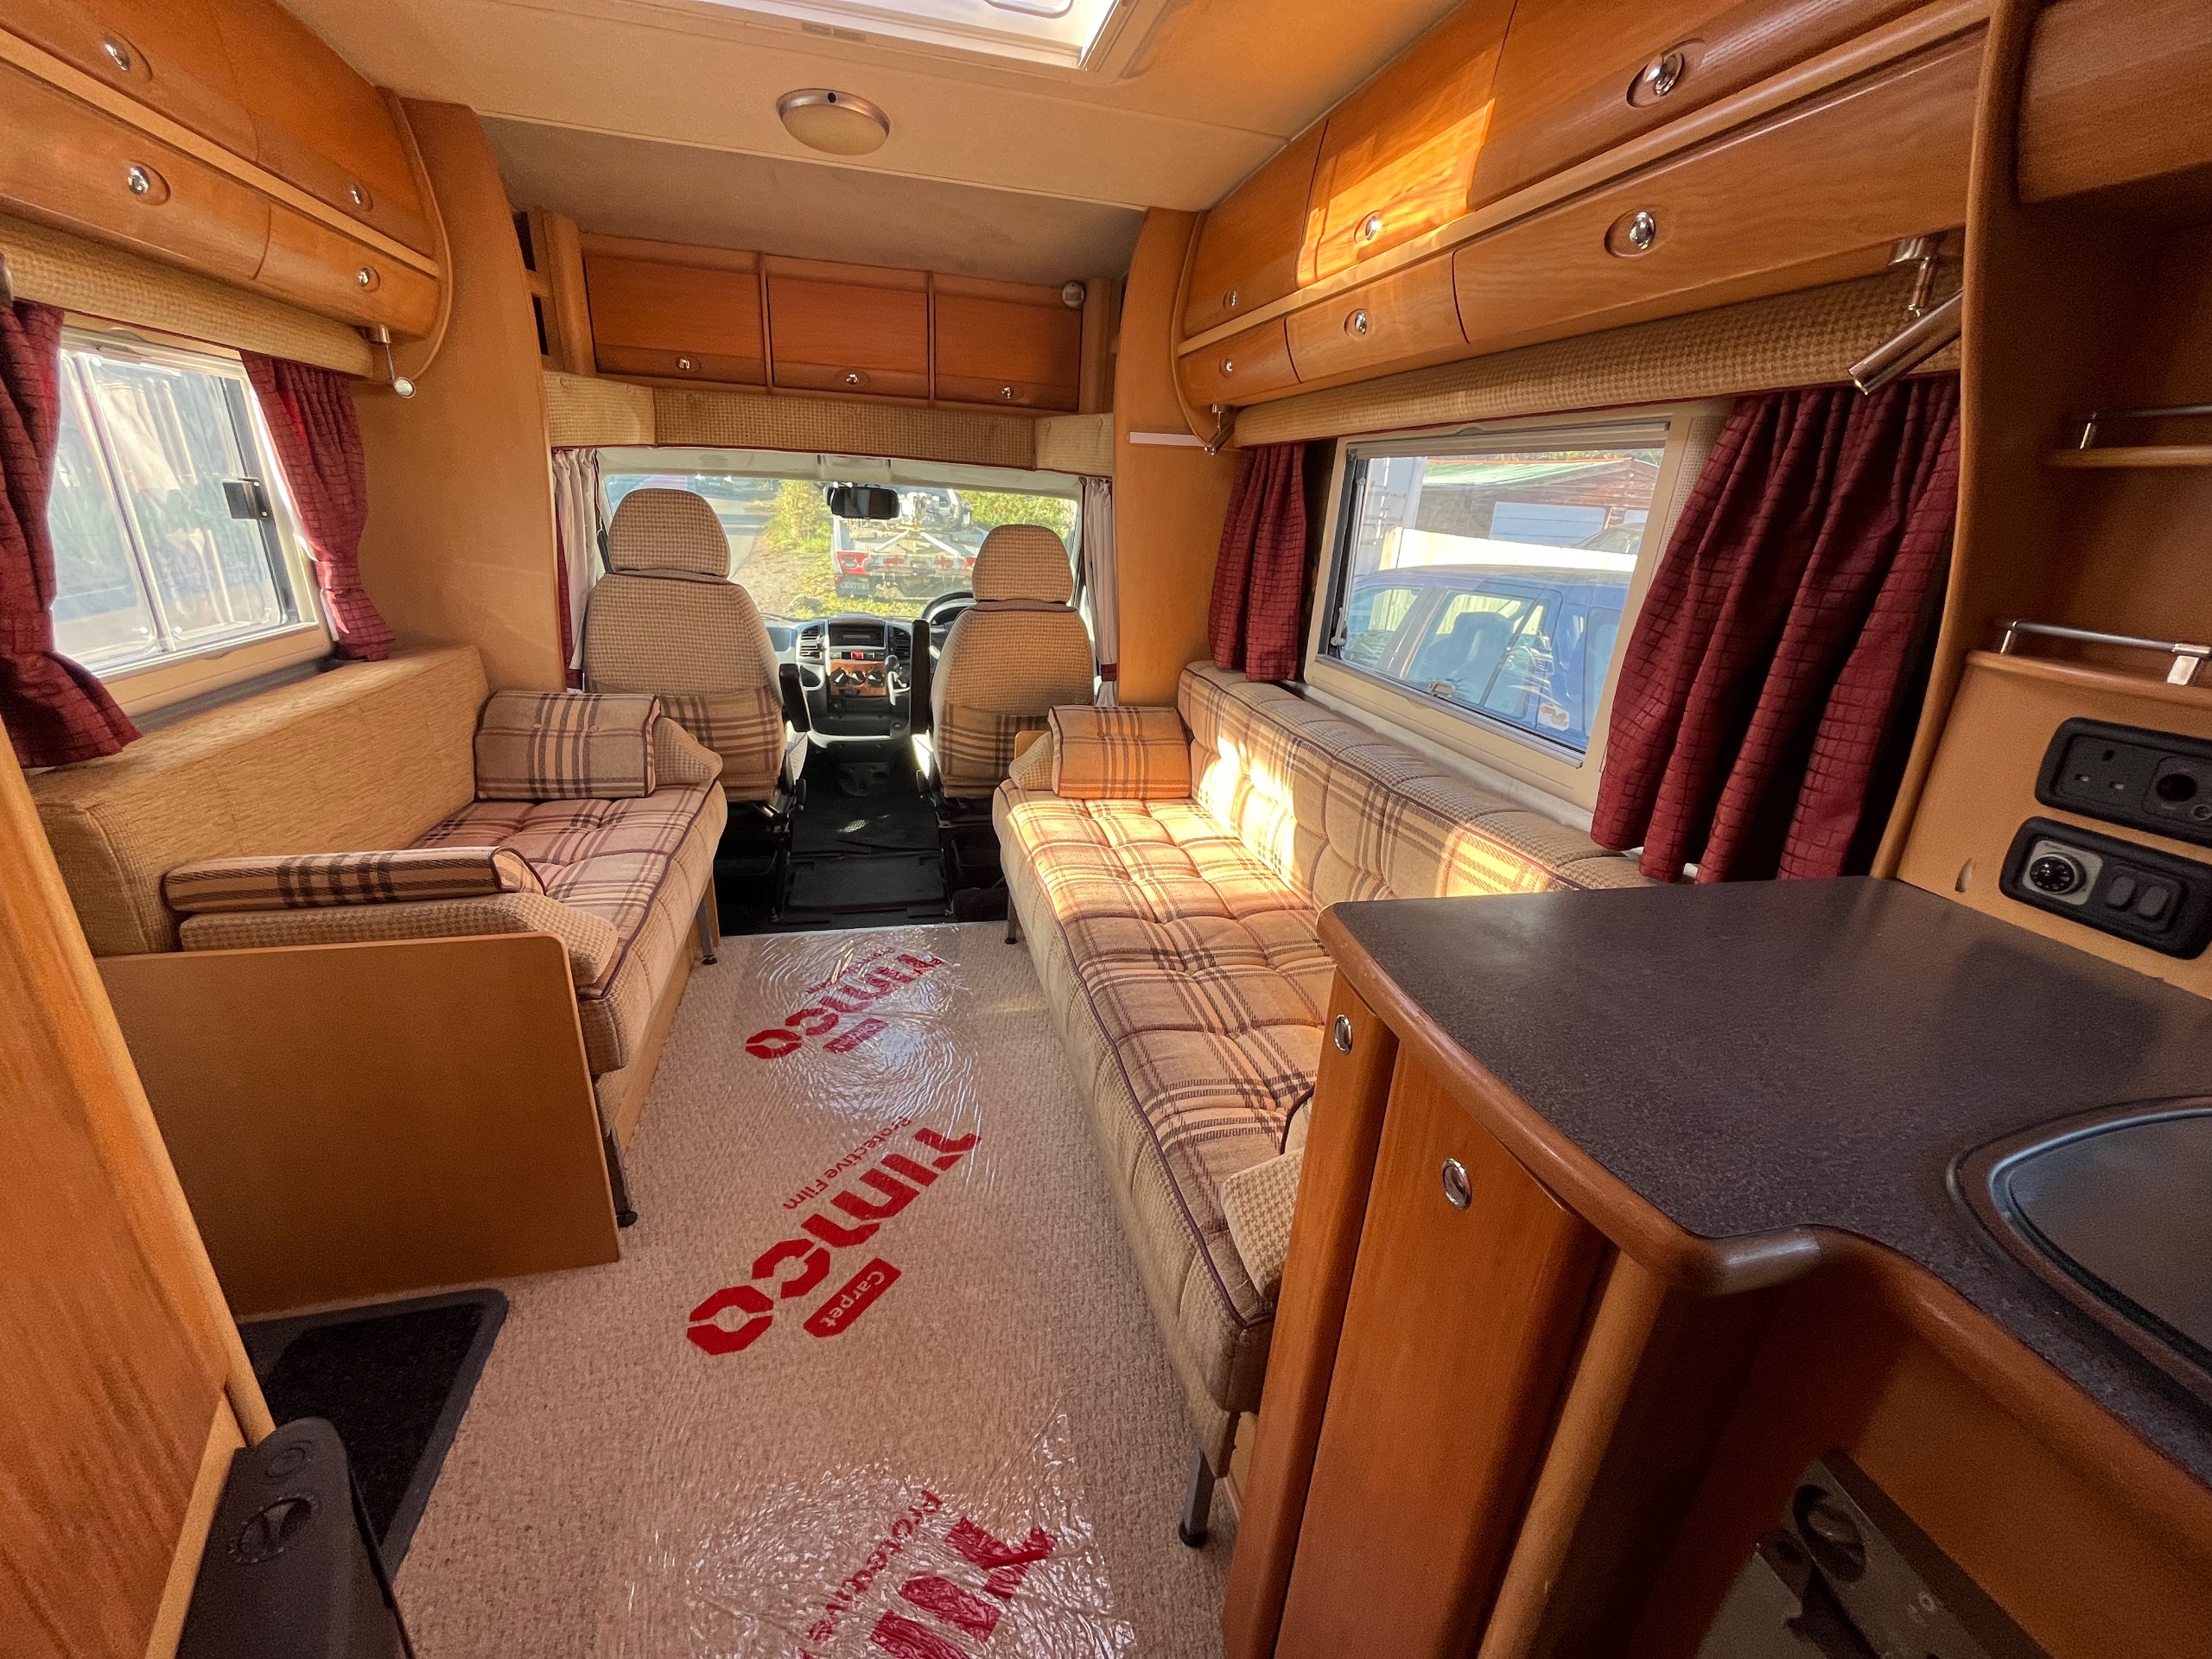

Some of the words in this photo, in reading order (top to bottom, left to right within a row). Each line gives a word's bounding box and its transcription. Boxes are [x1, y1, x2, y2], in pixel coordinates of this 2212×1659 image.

[823, 1116, 912, 1180] Protective
[782, 1177, 830, 1211] Film
[820, 1270, 886, 1328] Carpet
